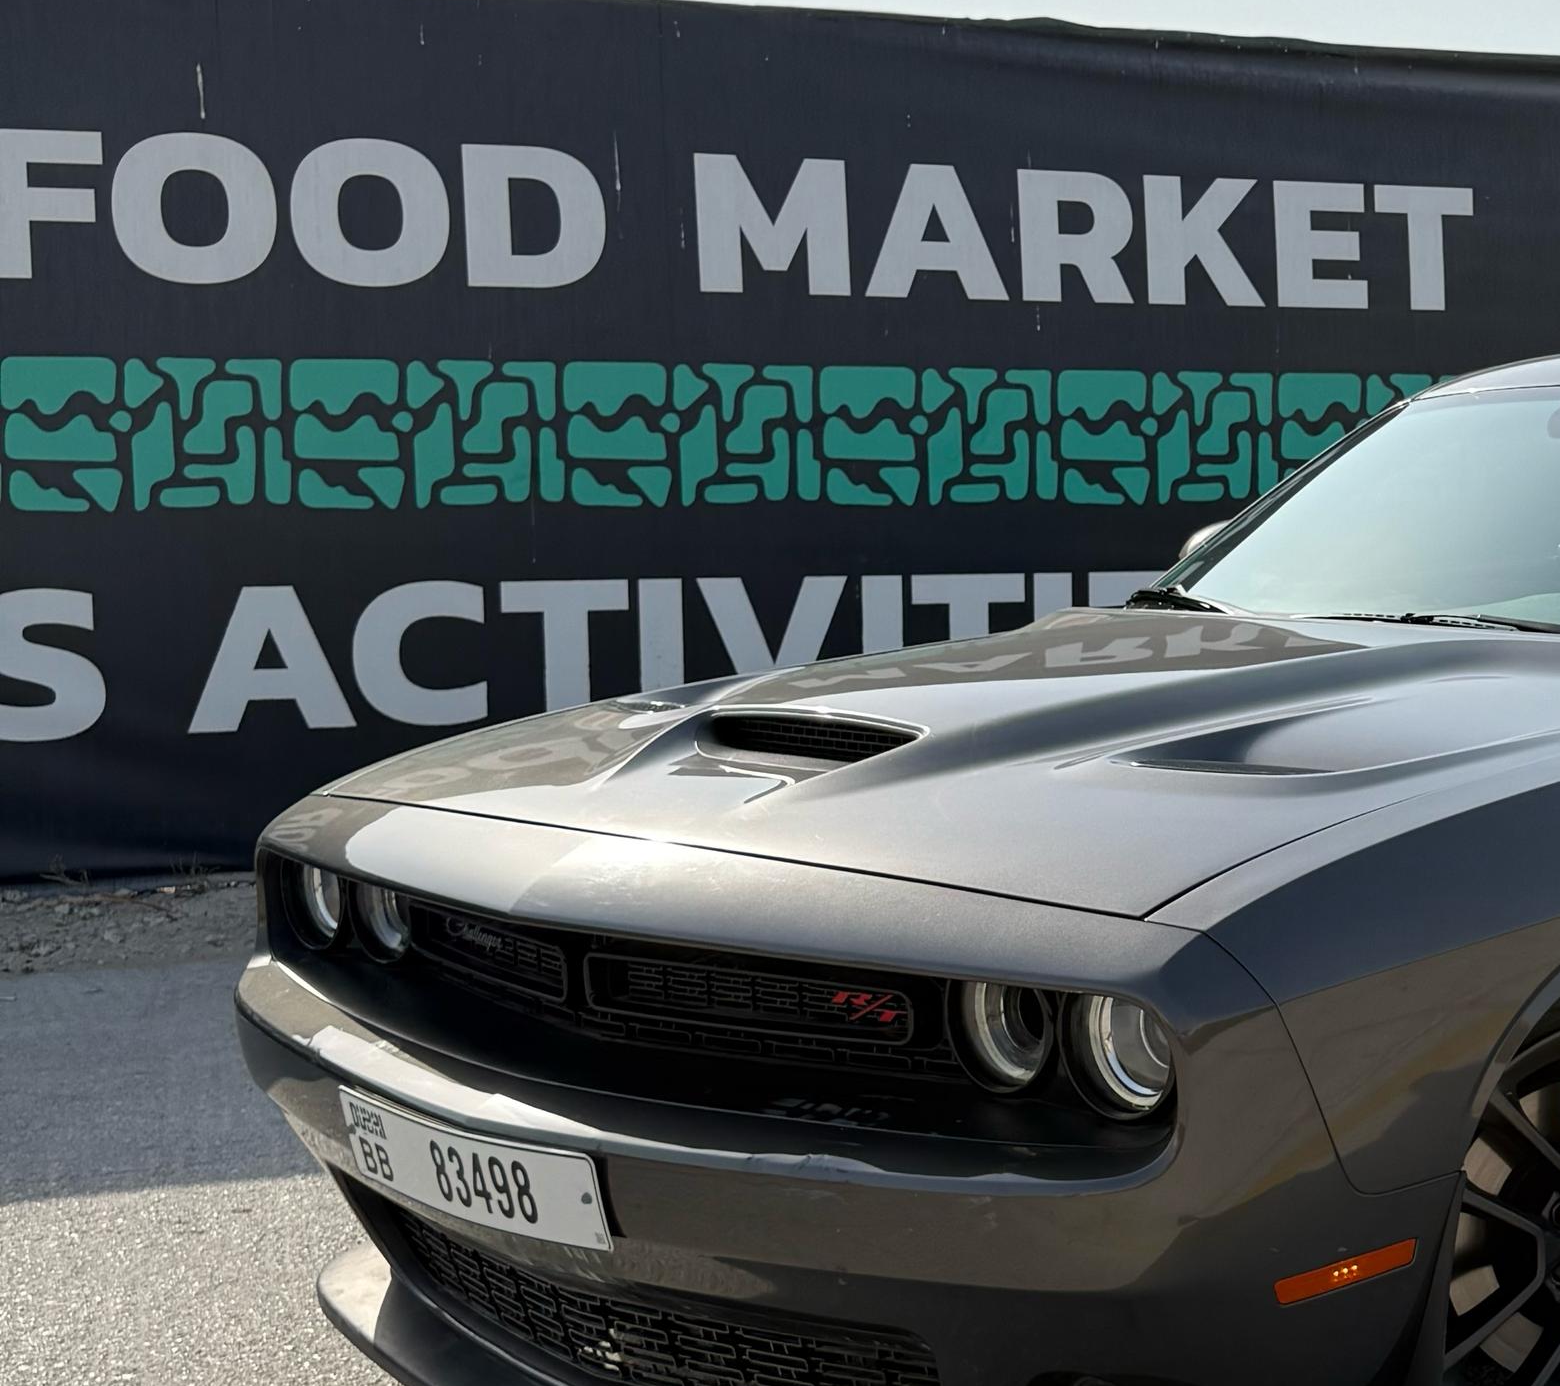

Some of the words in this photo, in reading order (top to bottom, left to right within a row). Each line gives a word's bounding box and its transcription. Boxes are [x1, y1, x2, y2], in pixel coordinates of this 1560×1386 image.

[0, 128, 607, 289] FOOD
[693, 153, 1474, 312] MARKET
[831, 991, 897, 1023] R/T
[359, 1135, 394, 1182] BB
[429, 1140, 539, 1224] 83498
